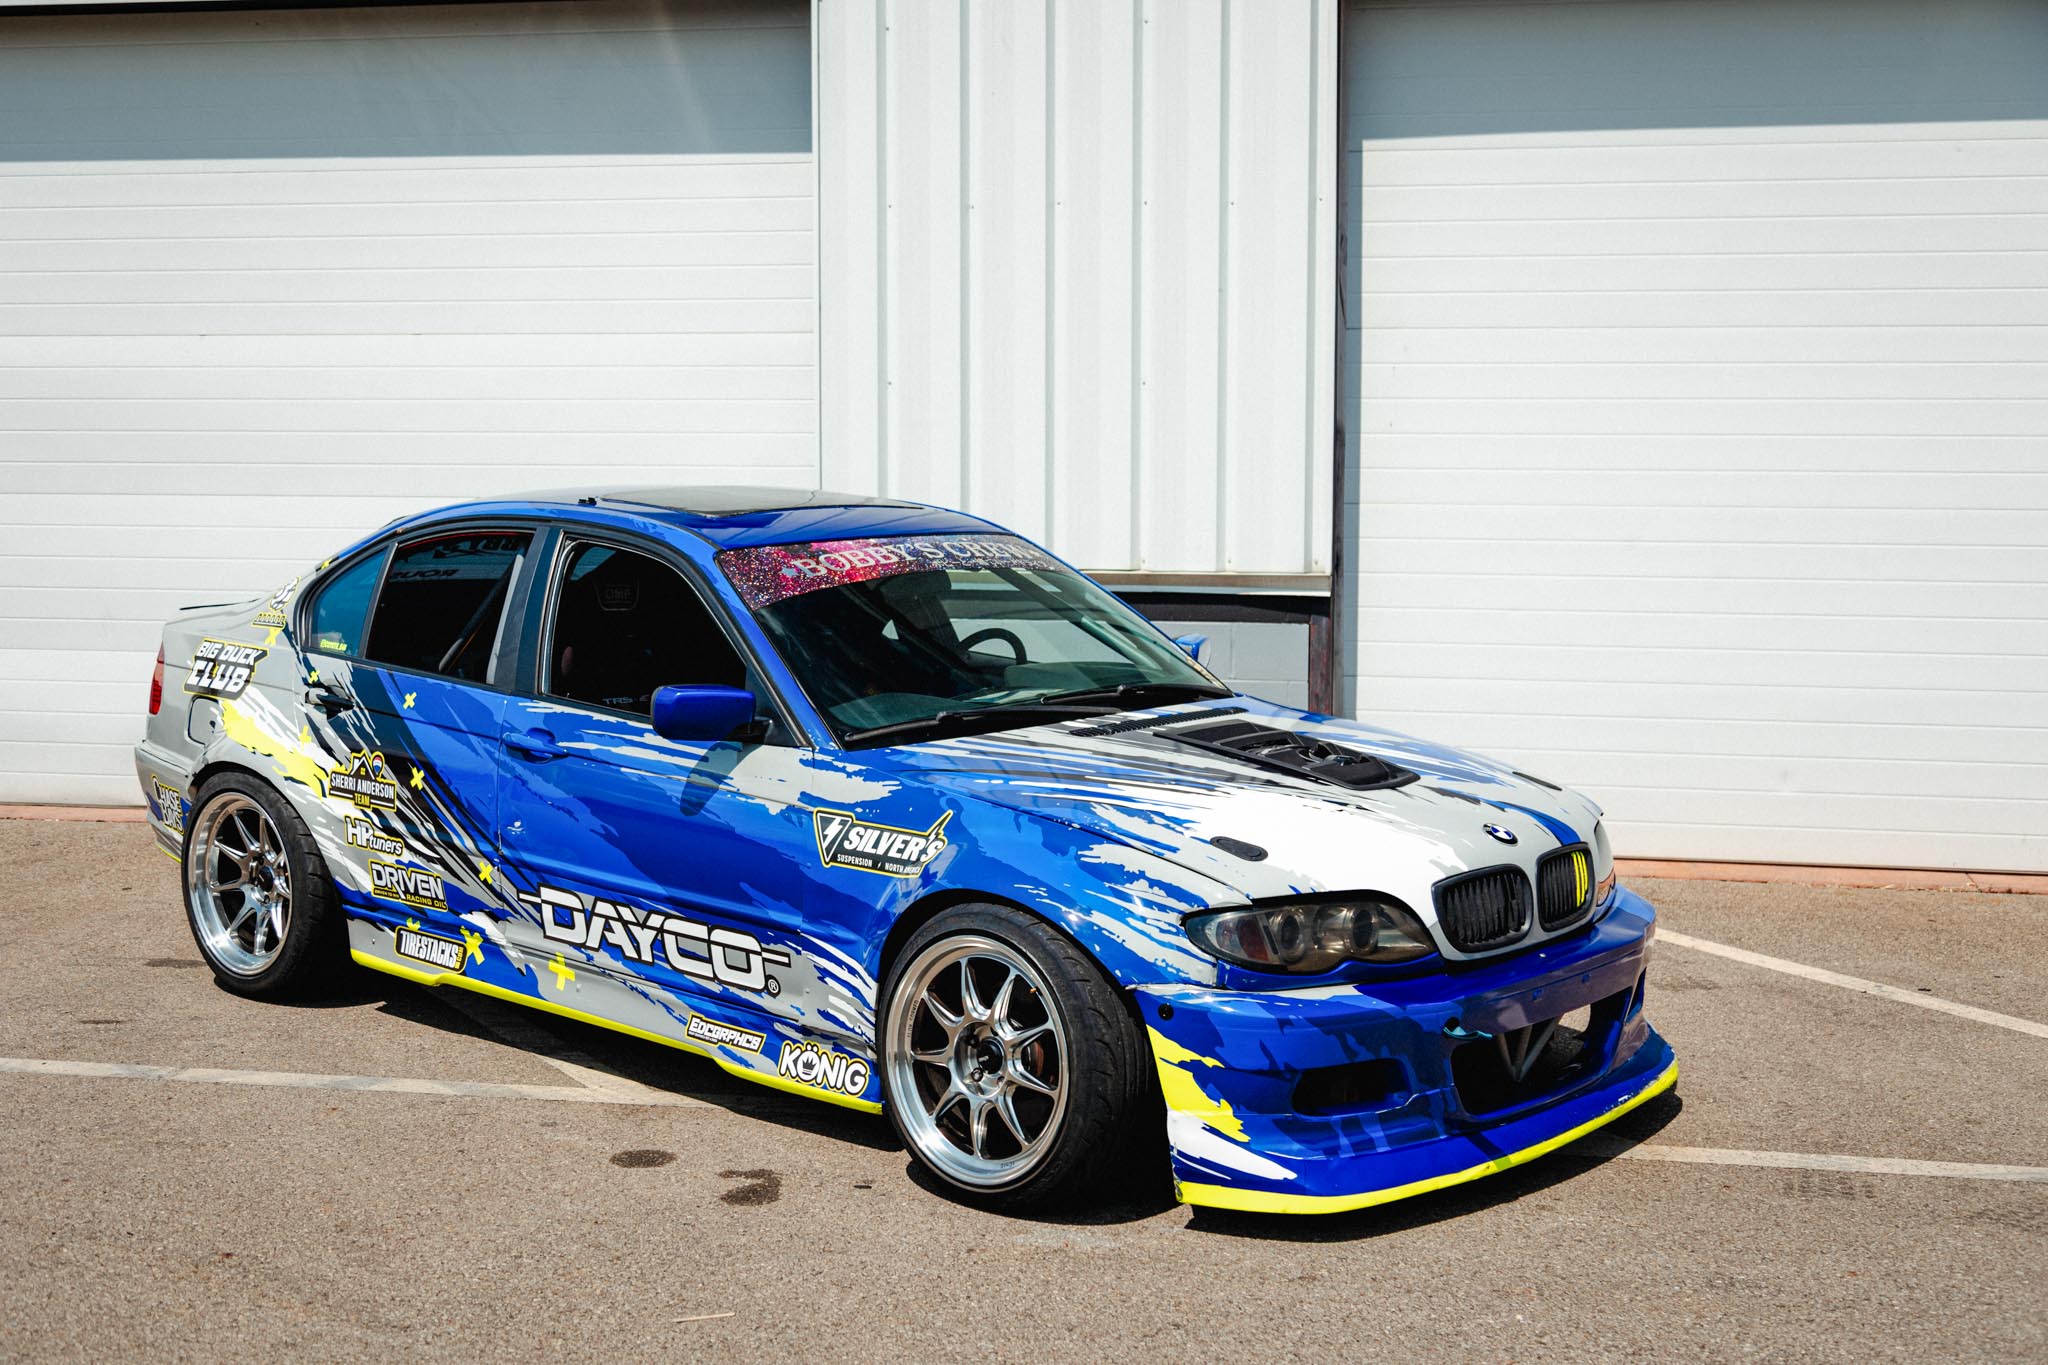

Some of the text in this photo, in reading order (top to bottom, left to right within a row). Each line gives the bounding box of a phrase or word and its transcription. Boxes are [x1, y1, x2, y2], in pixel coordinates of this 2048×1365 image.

[793, 541, 945, 577] BOBBY'S
[943, 541, 1033, 561] CREW
[197, 641, 264, 666] BIG DUCK
[187, 660, 250, 693] CLUB
[152, 777, 181, 813] CHASE
[331, 773, 394, 800] SHERRI ANDERSON
[354, 793, 371, 806] TEAM
[161, 800, 184, 832] DAYS
[345, 816, 403, 856] HPtuners
[843, 825, 944, 863] SILVER'S
[371, 863, 445, 900] DRIVEN
[837, 854, 873, 868] SUSPENSION
[884, 862, 902, 873] NORTH
[406, 894, 447, 909] RACING OIL
[399, 930, 459, 969] TIRESTACKS
[518, 884, 790, 992] DAYCO
[780, 1043, 867, 1095] KÖNIG
